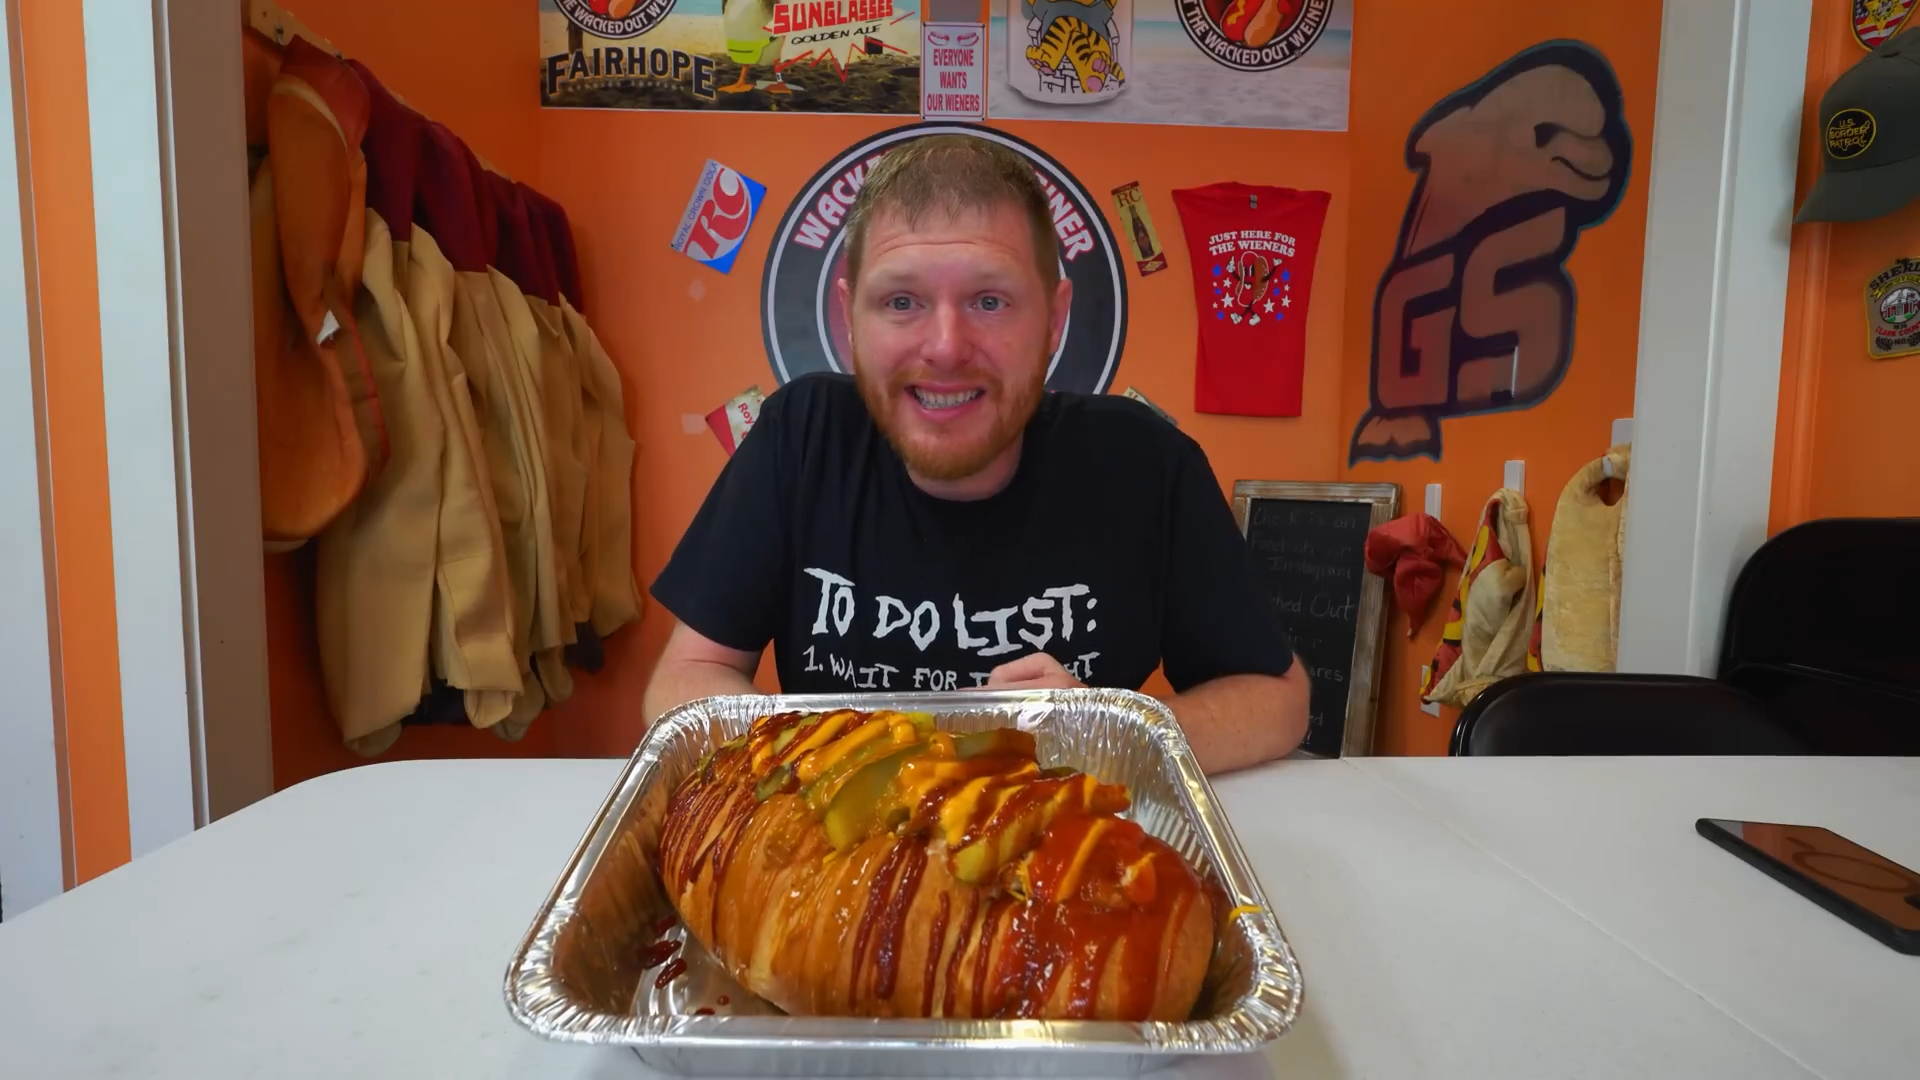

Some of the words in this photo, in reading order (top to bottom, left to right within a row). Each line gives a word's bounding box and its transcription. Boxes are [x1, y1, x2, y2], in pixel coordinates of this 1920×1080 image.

[574, 7, 623, 34] WACKED
[624, 14, 649, 32] OUT
[773, 0, 893, 34] SUNGLASSES
[791, 30, 850, 45] GOLDEN
[1187, 6, 1207, 36] THE
[1204, 29, 1260, 64] WACKED
[1261, 44, 1291, 63] OUT
[933, 48, 974, 67] EVERYONE
[546, 46, 717, 100] FAIRHOPE
[939, 72, 967, 90] WANTS
[927, 95, 944, 111] OUR
[945, 94, 980, 112] WIENERS
[1830, 126, 1867, 139] BORDER
[1830, 136, 1867, 149] PATROL
[674, 223, 692, 250] ROYAL
[688, 187, 708, 220] CROWN
[703, 162, 719, 186] COLA
[1116, 187, 1141, 208] RC
[1209, 231, 1237, 245] JUST
[1240, 230, 1272, 239] HERE
[1274, 232, 1296, 246] FOR
[1209, 242, 1235, 256] THE
[1237, 240, 1296, 257] WIENERS
[1377, 206, 1565, 409] GS
[804, 567, 855, 636] TO
[873, 595, 940, 652] DO
[953, 583, 1099, 657] LIST:
[1310, 591, 1357, 622] Out
[803, 645, 823, 672] 1.
[830, 653, 900, 688] WAIT
[913, 667, 957, 691] FOR
